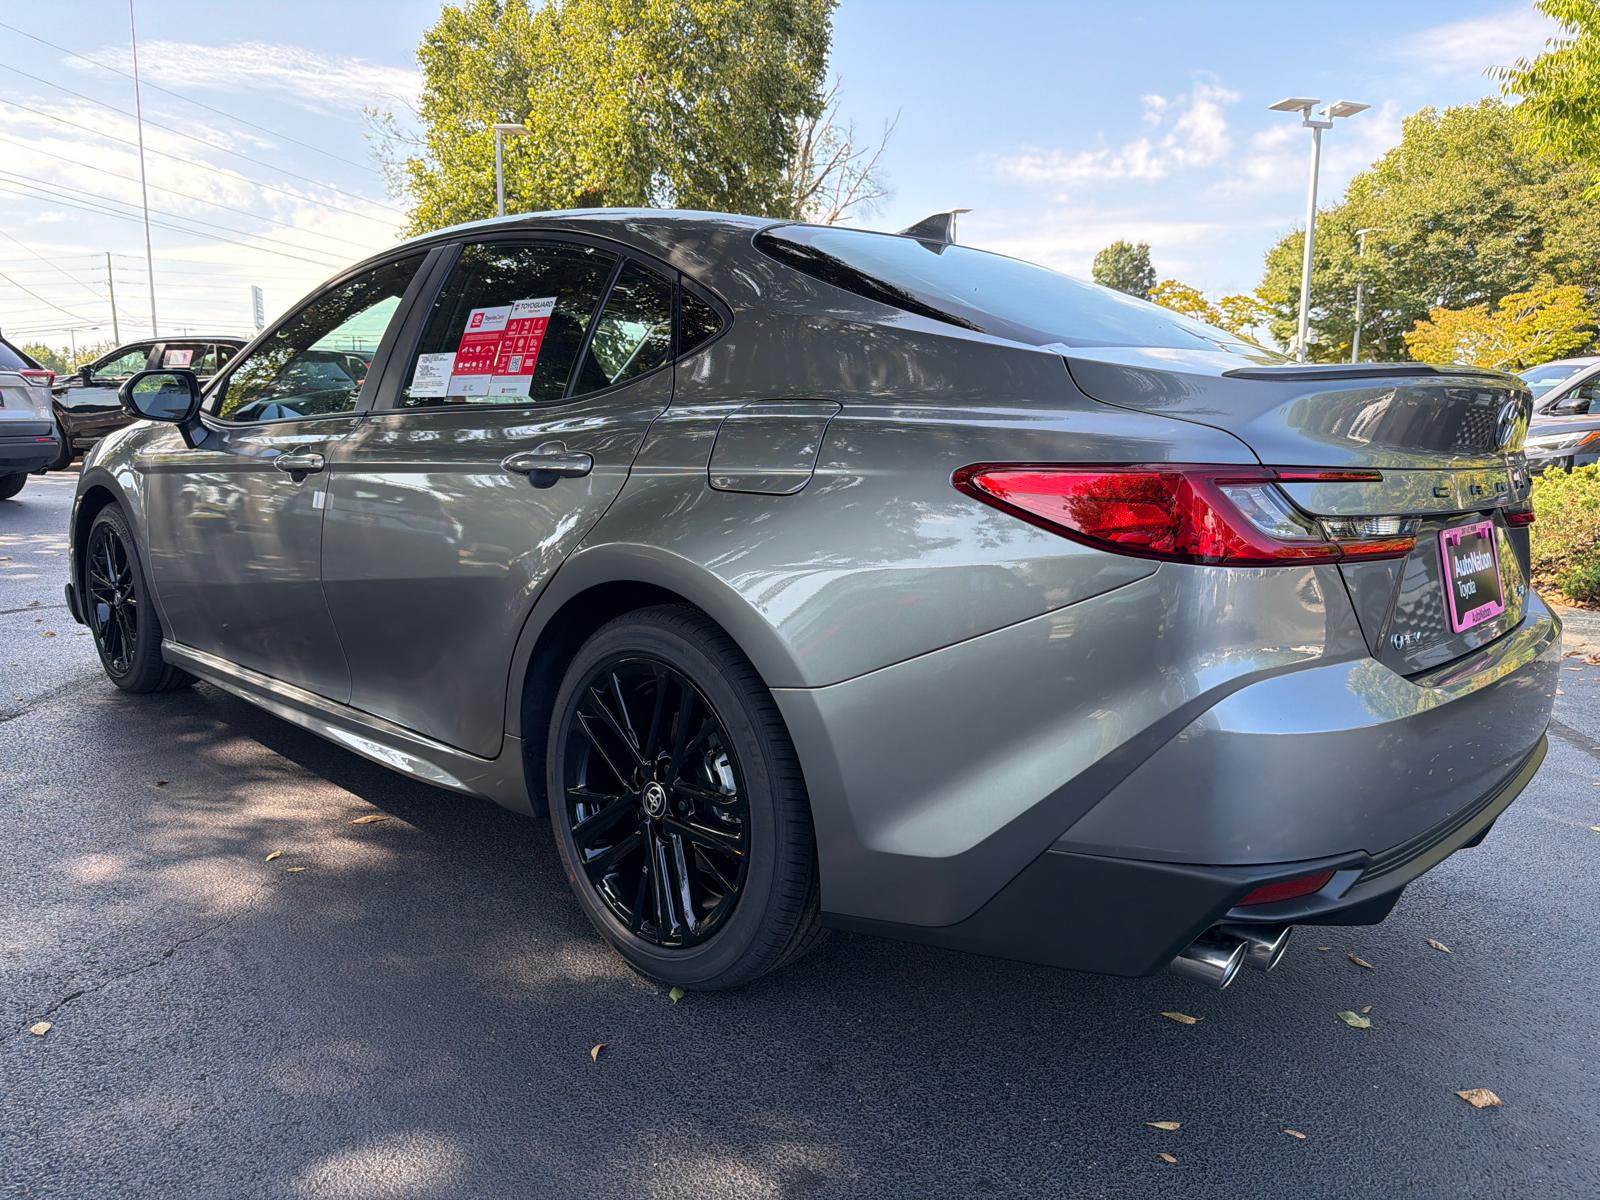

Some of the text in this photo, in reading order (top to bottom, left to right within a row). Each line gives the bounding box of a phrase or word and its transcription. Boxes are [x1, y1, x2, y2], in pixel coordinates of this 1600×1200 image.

[520, 301, 554, 310] TOYOGUARD
[1454, 550, 1493, 579] AutoNation
[1457, 578, 1477, 600] Toyota
[1472, 606, 1492, 624] AutoNation
